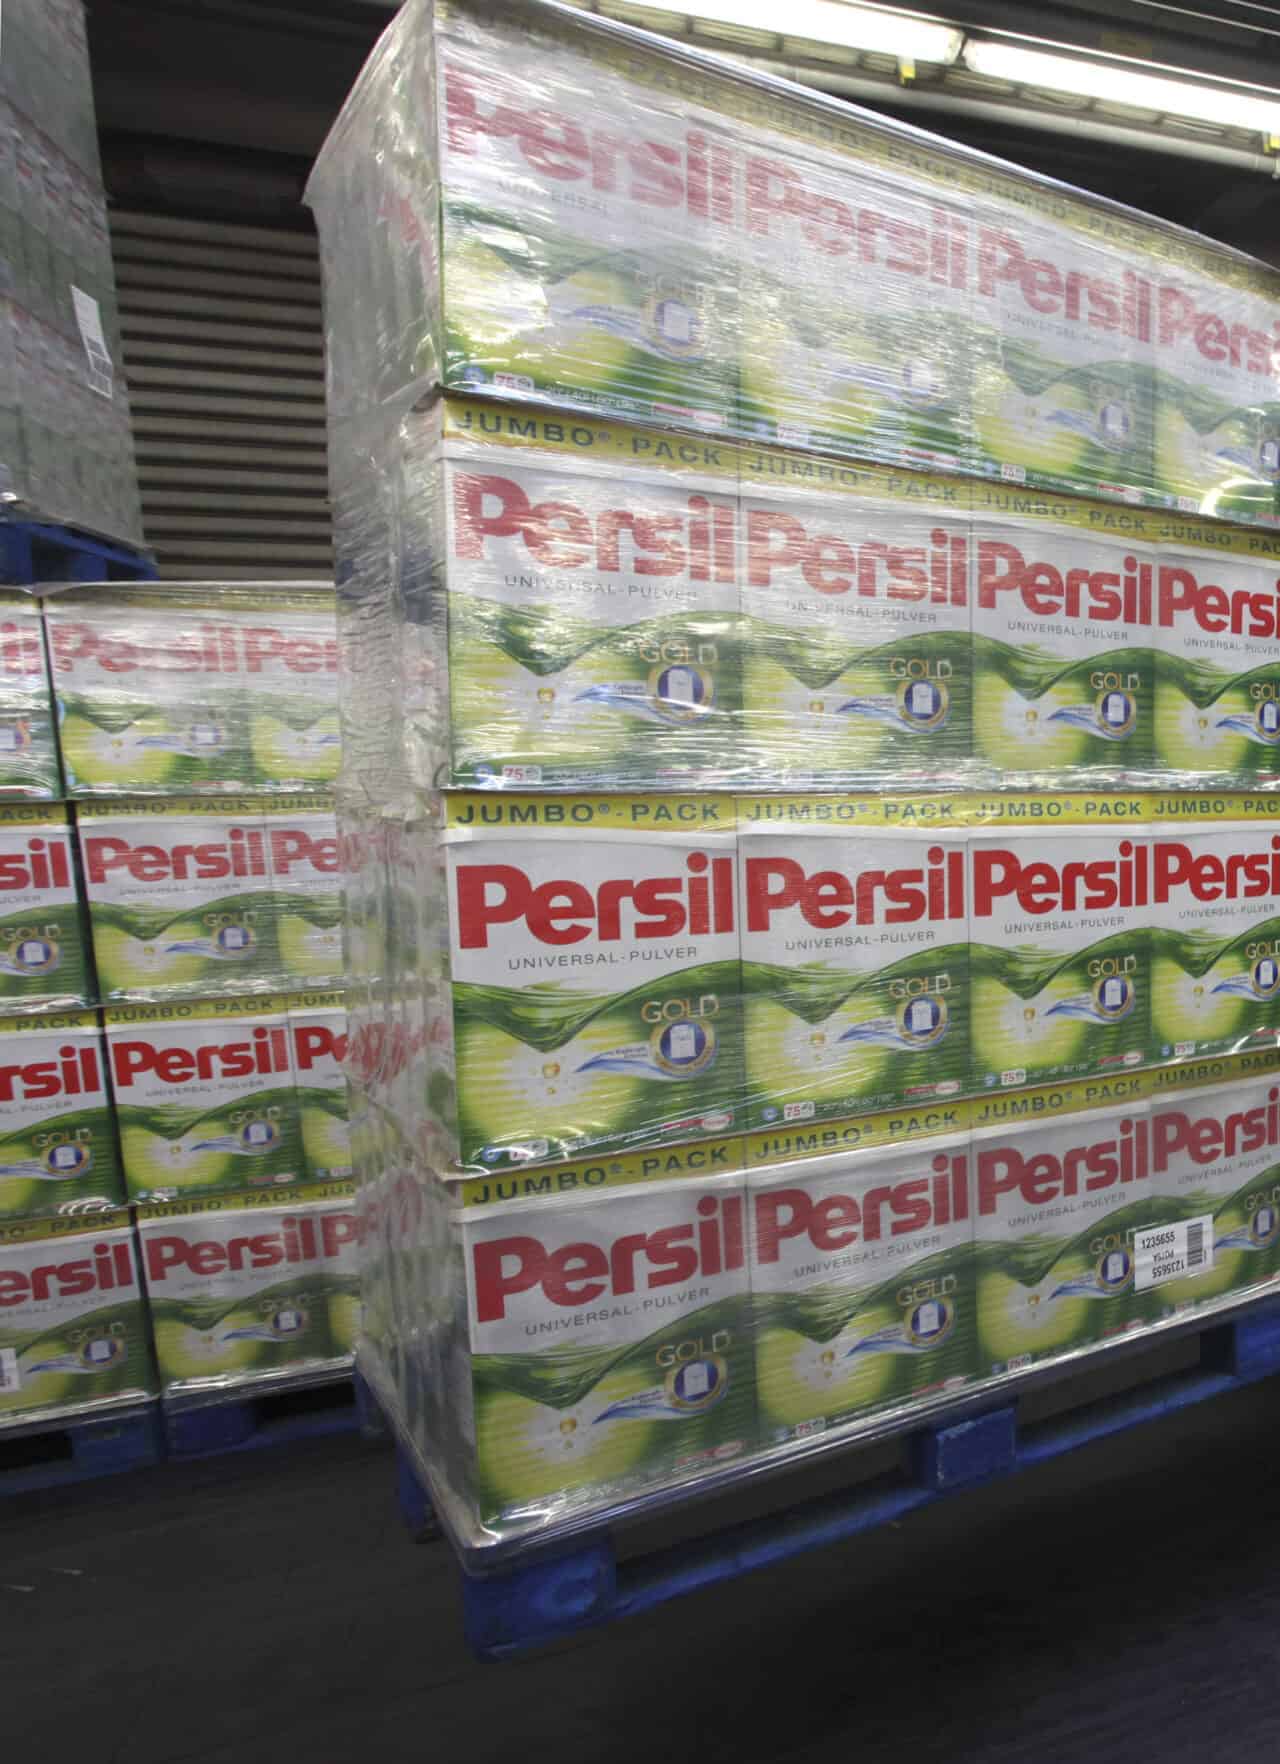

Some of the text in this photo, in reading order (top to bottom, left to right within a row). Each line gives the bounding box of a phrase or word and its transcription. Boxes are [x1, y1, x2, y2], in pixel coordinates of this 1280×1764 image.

[445, 62, 733, 225] Persil
[745, 155, 969, 290] Persil
[976, 221, 1151, 344] Persil
[454, 471, 735, 585] Persil
[747, 510, 968, 608] Persil
[977, 539, 1152, 626] Persil
[891, 658, 952, 679] GOLD
[1090, 672, 1140, 691] GOLD
[85, 828, 265, 884] Persil
[745, 846, 965, 932] Persil
[973, 840, 1148, 917] Persil
[456, 851, 735, 949] Persil
[508, 946, 697, 970] UNIVERSAL-PULVER
[785, 930, 935, 950] UNIVERSAL-PULVER
[1088, 953, 1137, 978] GOLD
[641, 994, 719, 1023] GOLD
[889, 972, 952, 999] GOLD
[112, 1027, 289, 1087] Persil
[977, 1118, 1148, 1216] Persil
[755, 1154, 968, 1265] Persil
[0, 1243, 133, 1306] ersil
[146, 1217, 316, 1281] Persil
[472, 1196, 745, 1323] Persil
[656, 1329, 731, 1367] GOLD
